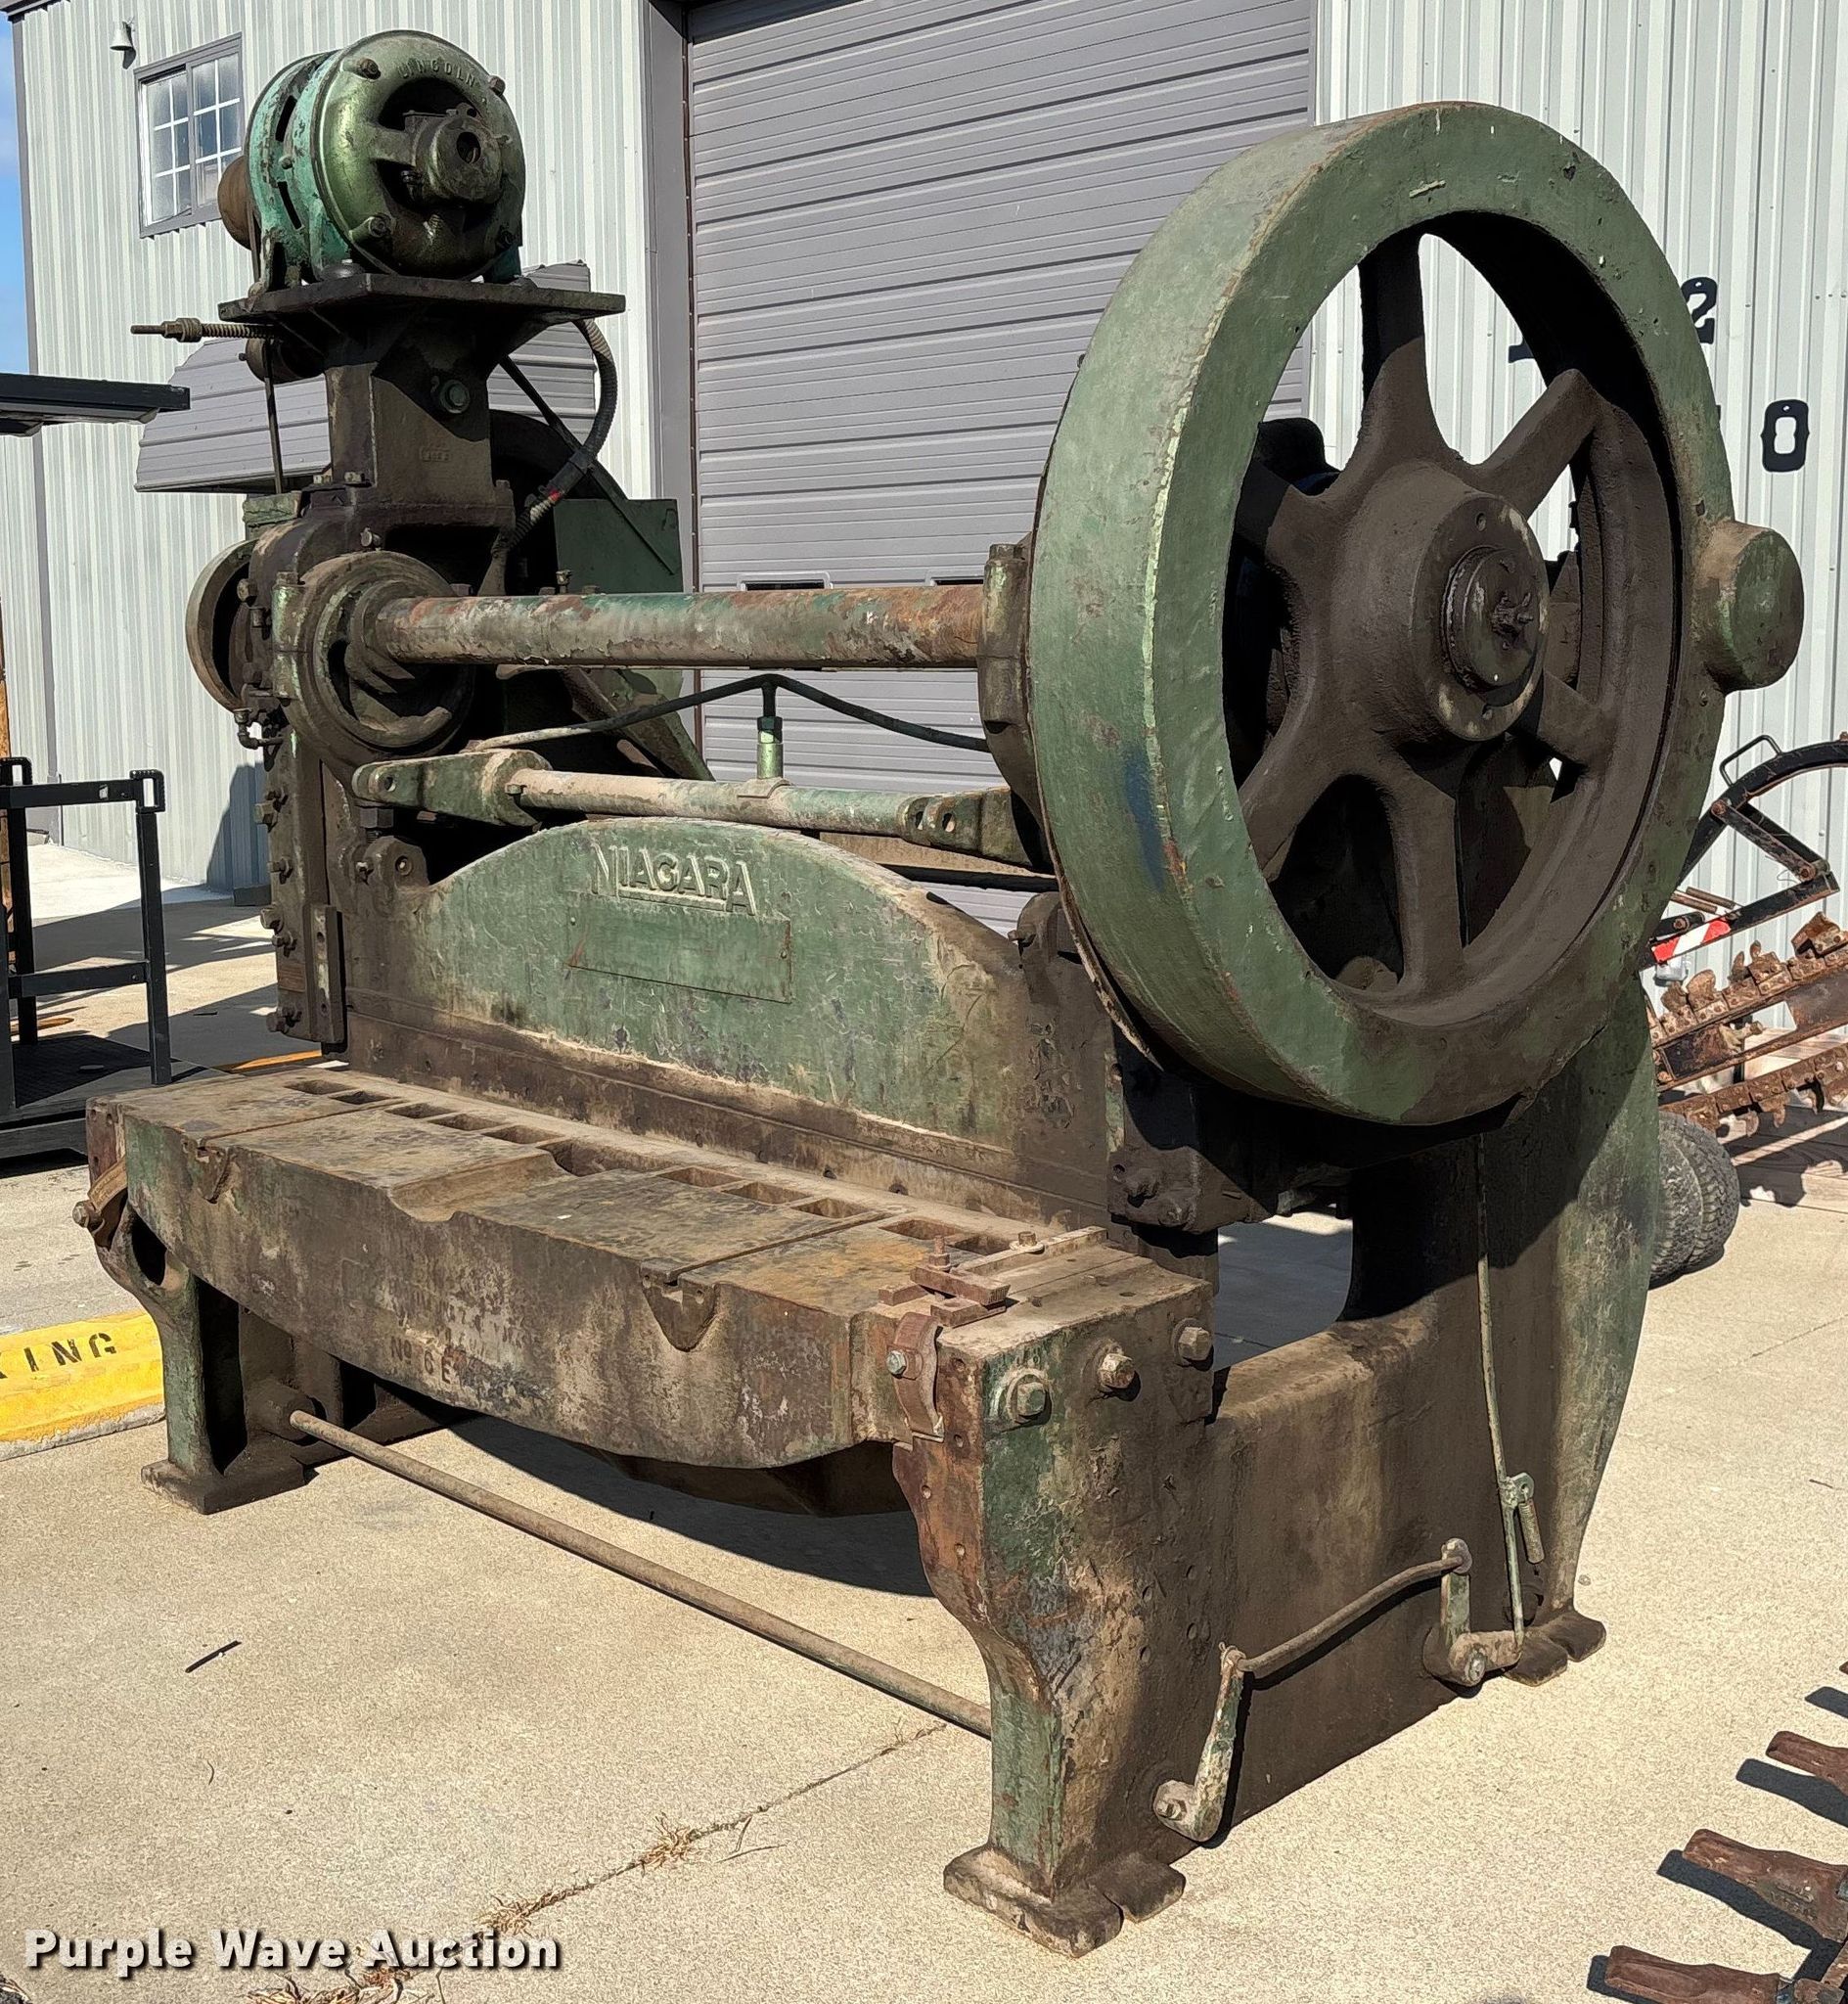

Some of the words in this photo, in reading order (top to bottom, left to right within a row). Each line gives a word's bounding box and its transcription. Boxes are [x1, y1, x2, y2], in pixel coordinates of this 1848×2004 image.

[398, 58, 475, 88] LINCOLN
[591, 843, 757, 915] NIAGARA
[0, 1332, 116, 1379] ING
